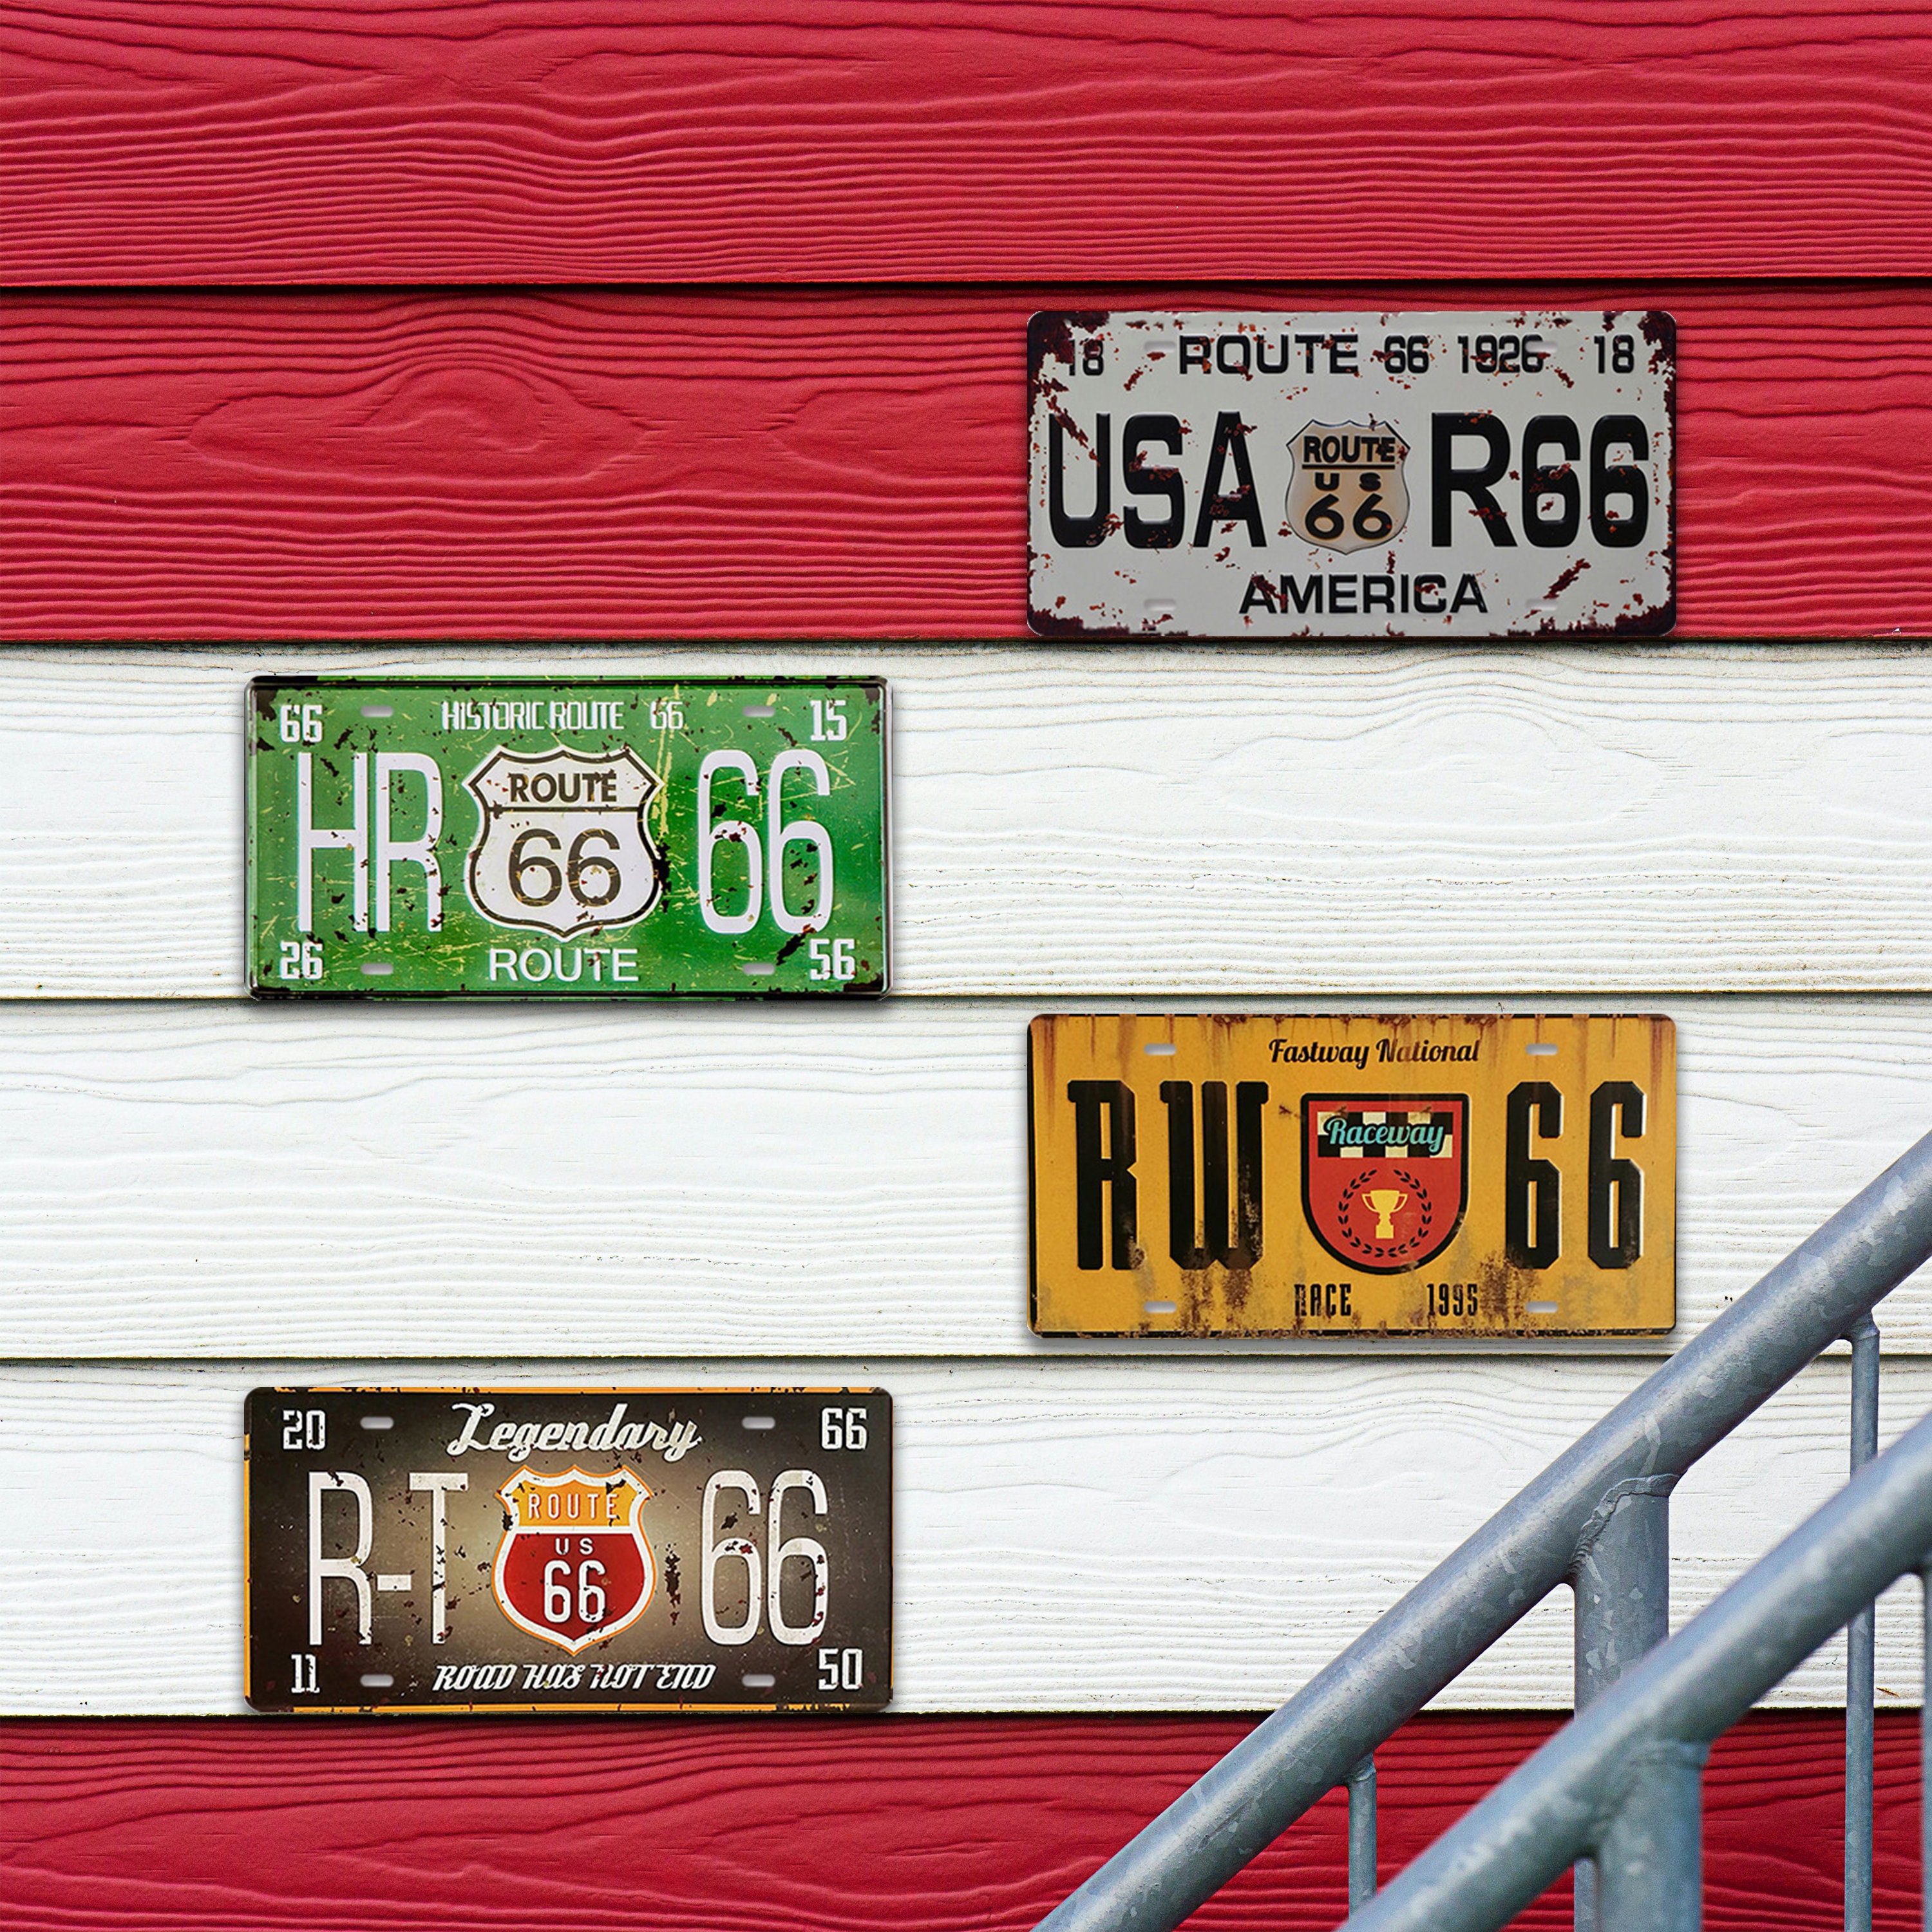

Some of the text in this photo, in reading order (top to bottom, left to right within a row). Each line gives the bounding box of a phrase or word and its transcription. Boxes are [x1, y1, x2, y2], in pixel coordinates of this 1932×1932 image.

[1068, 337, 1104, 375] 18
[1178, 335, 1544, 374] ROUTE 66 1926
[1594, 335, 1635, 374] 18
[1303, 435, 1396, 463] ROUTE
[1048, 411, 1267, 548] USA
[1431, 412, 1649, 547] R66
[1303, 494, 1392, 540] 66
[1238, 573, 1488, 614] AMERICA
[279, 704, 323, 742] 66
[441, 701, 683, 732] HISTORIC ROUTE 66
[810, 700, 847, 741] 15
[509, 772, 618, 803] ROUTE
[297, 752, 444, 933] HR
[699, 750, 833, 934] 66
[507, 828, 622, 907] 66
[279, 942, 323, 980] 26
[489, 948, 639, 982] ROUTE
[809, 939, 855, 981] 56
[1269, 1037, 1479, 1070] Fastway National
[1323, 1112, 1446, 1154] Raceway
[1506, 1081, 1647, 1270] 66
[1294, 1283, 1479, 1316] RACE 1995
[282, 1410, 326, 1450] 20
[445, 1403, 701, 1462] Legendary
[820, 1408, 867, 1450] 66
[527, 1493, 618, 1520] ROUTE
[308, 1472, 468, 1646] R-T
[554, 1537, 594, 1555] US
[703, 1470, 829, 1646] 66
[544, 1560, 606, 1623] 66
[290, 1654, 319, 1694] 11
[433, 1665, 515, 1692] ROAD
[818, 1648, 863, 1691] 50
